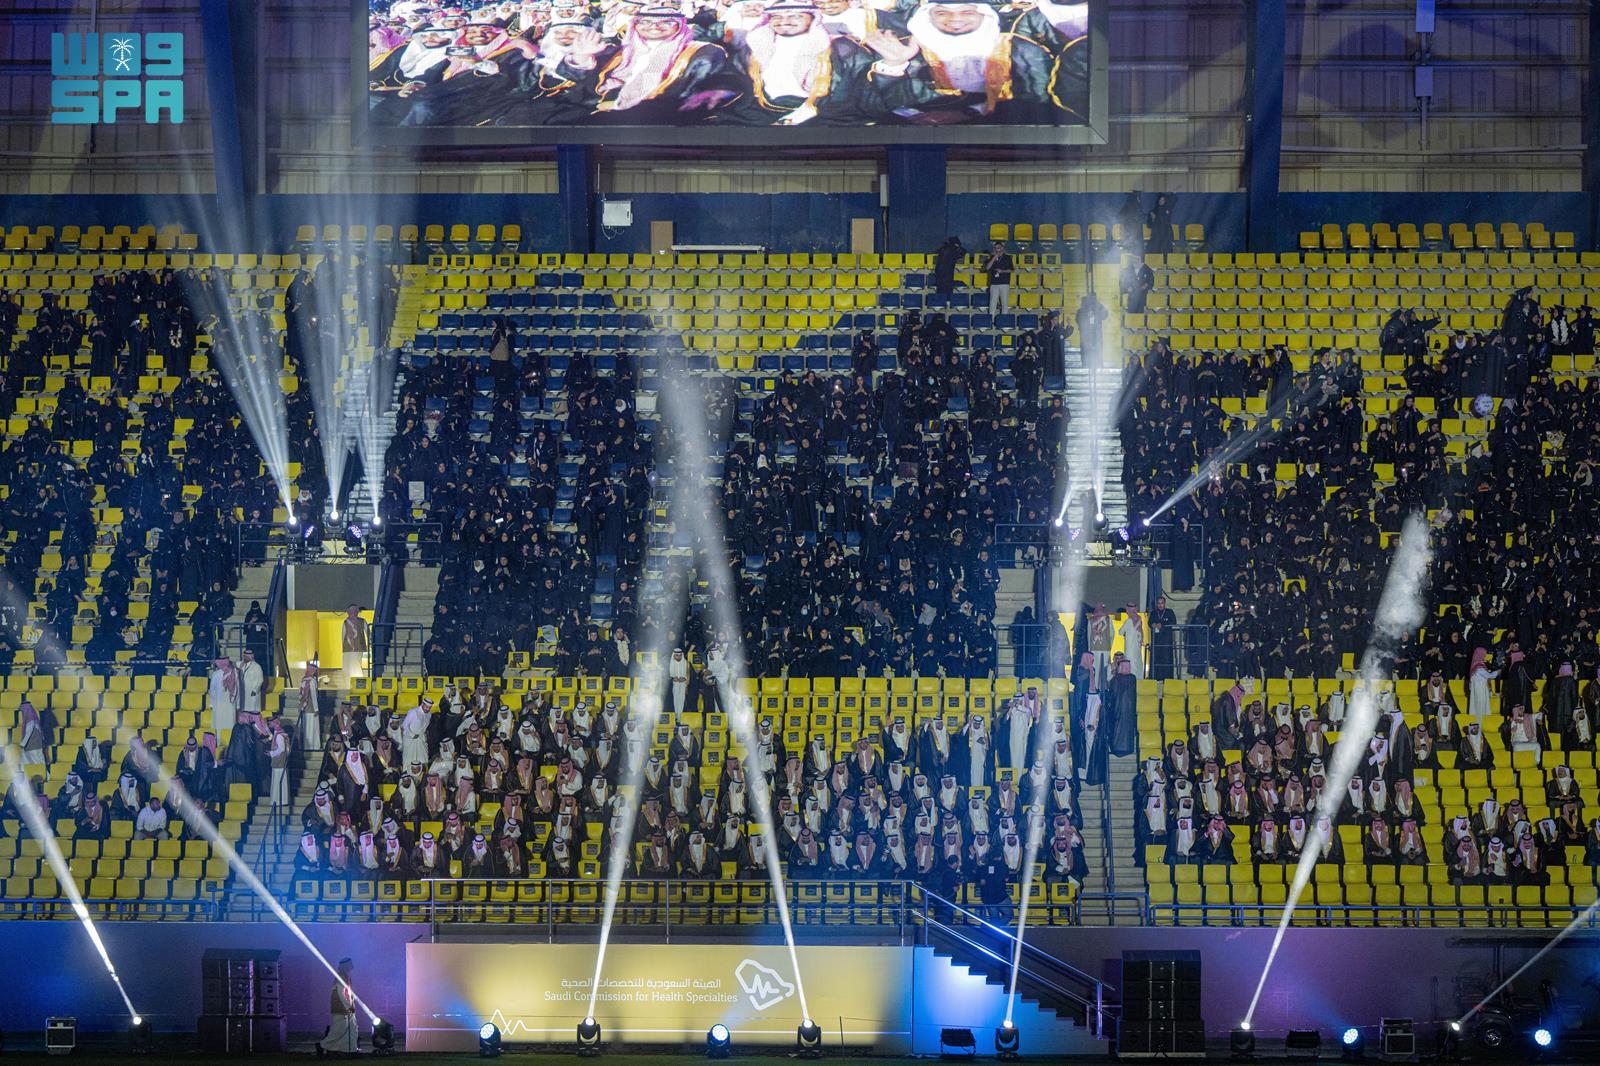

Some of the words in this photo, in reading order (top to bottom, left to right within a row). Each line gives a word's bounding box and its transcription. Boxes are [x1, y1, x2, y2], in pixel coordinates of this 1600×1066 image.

[561, 977, 593, 989] الصحية
[646, 978, 691, 990] السعودية
[693, 978, 721, 990] الهيئة
[543, 990, 571, 1001] Saudi
[635, 991, 648, 1001] for
[651, 991, 684, 1002] Health
[686, 991, 738, 1004] Specialties
